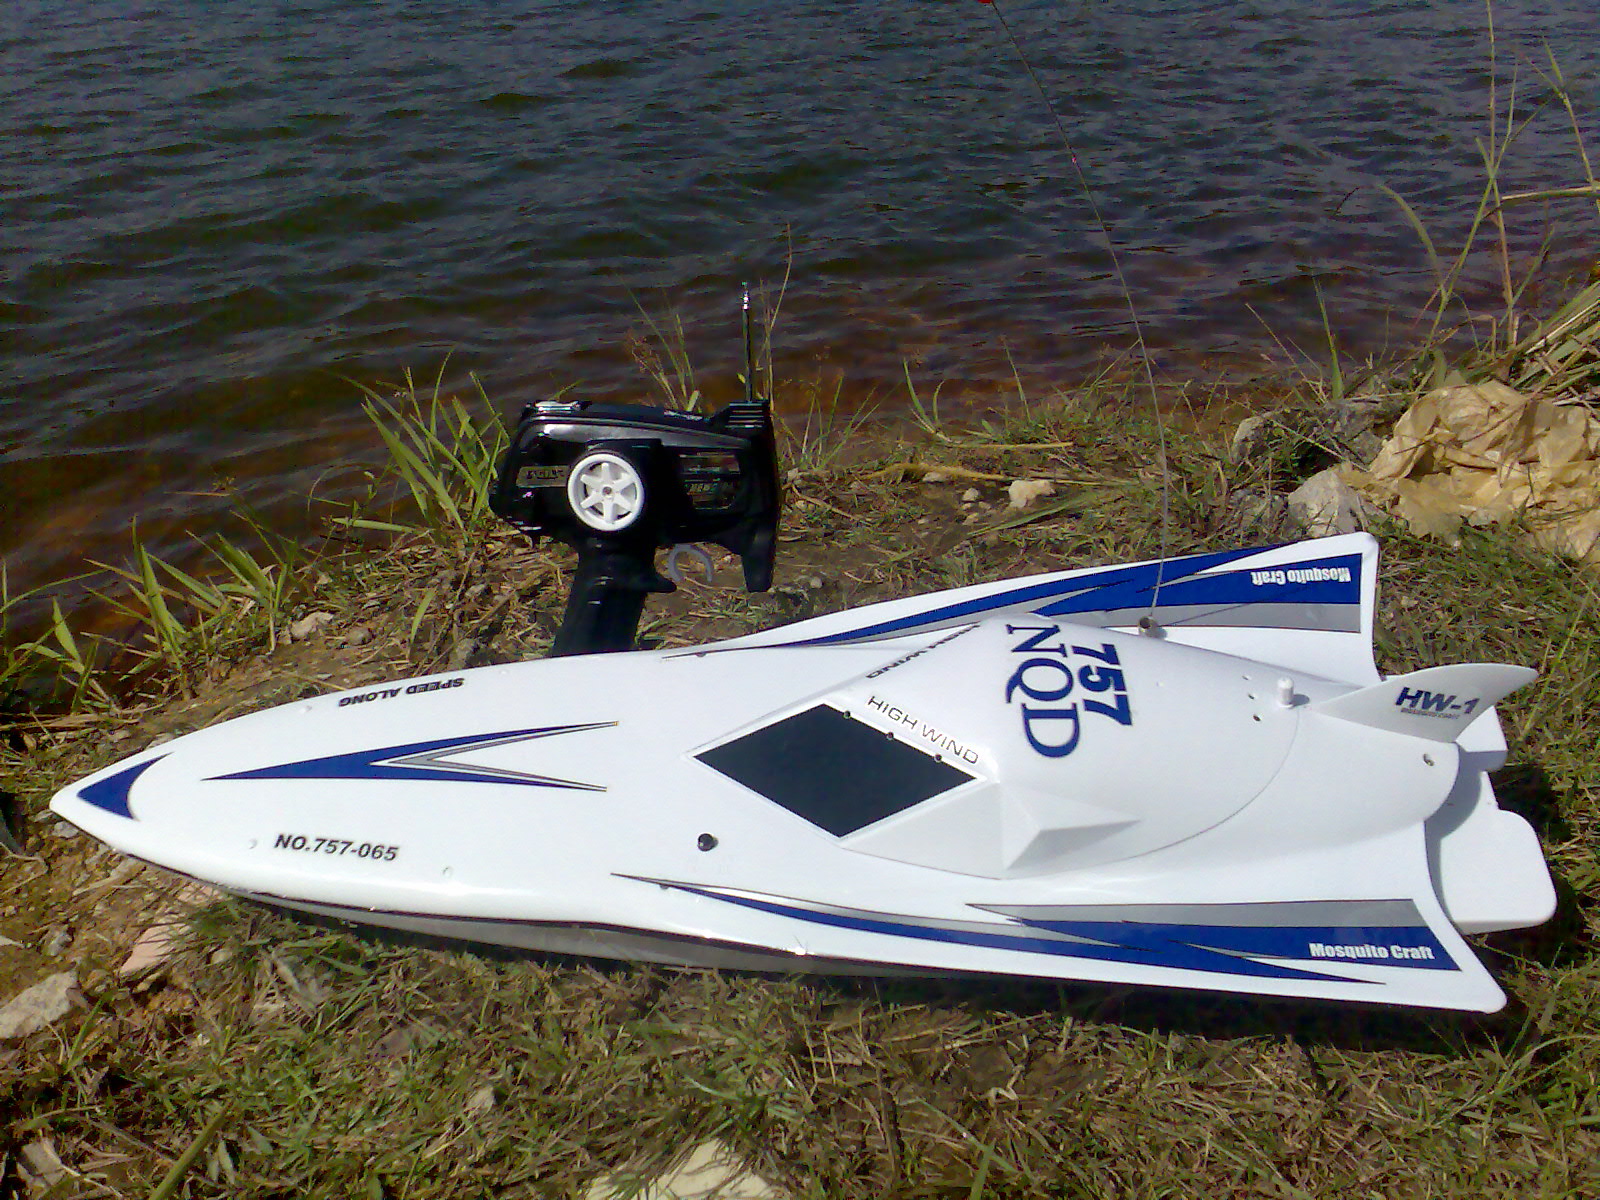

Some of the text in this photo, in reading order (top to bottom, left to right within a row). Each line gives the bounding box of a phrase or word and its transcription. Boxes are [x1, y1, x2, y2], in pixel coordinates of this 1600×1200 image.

[1250, 566, 1352, 586] Mosquito Craft
[338, 677, 465, 707] SPEED ALONG
[1005, 624, 1081, 758] NQD
[1070, 643, 1133, 726] 757
[1395, 686, 1480, 714] HW-1
[868, 695, 979, 764] HIGH WIND
[274, 833, 398, 861] NO.757-065
[1308, 942, 1435, 960] Mosquito Craft
